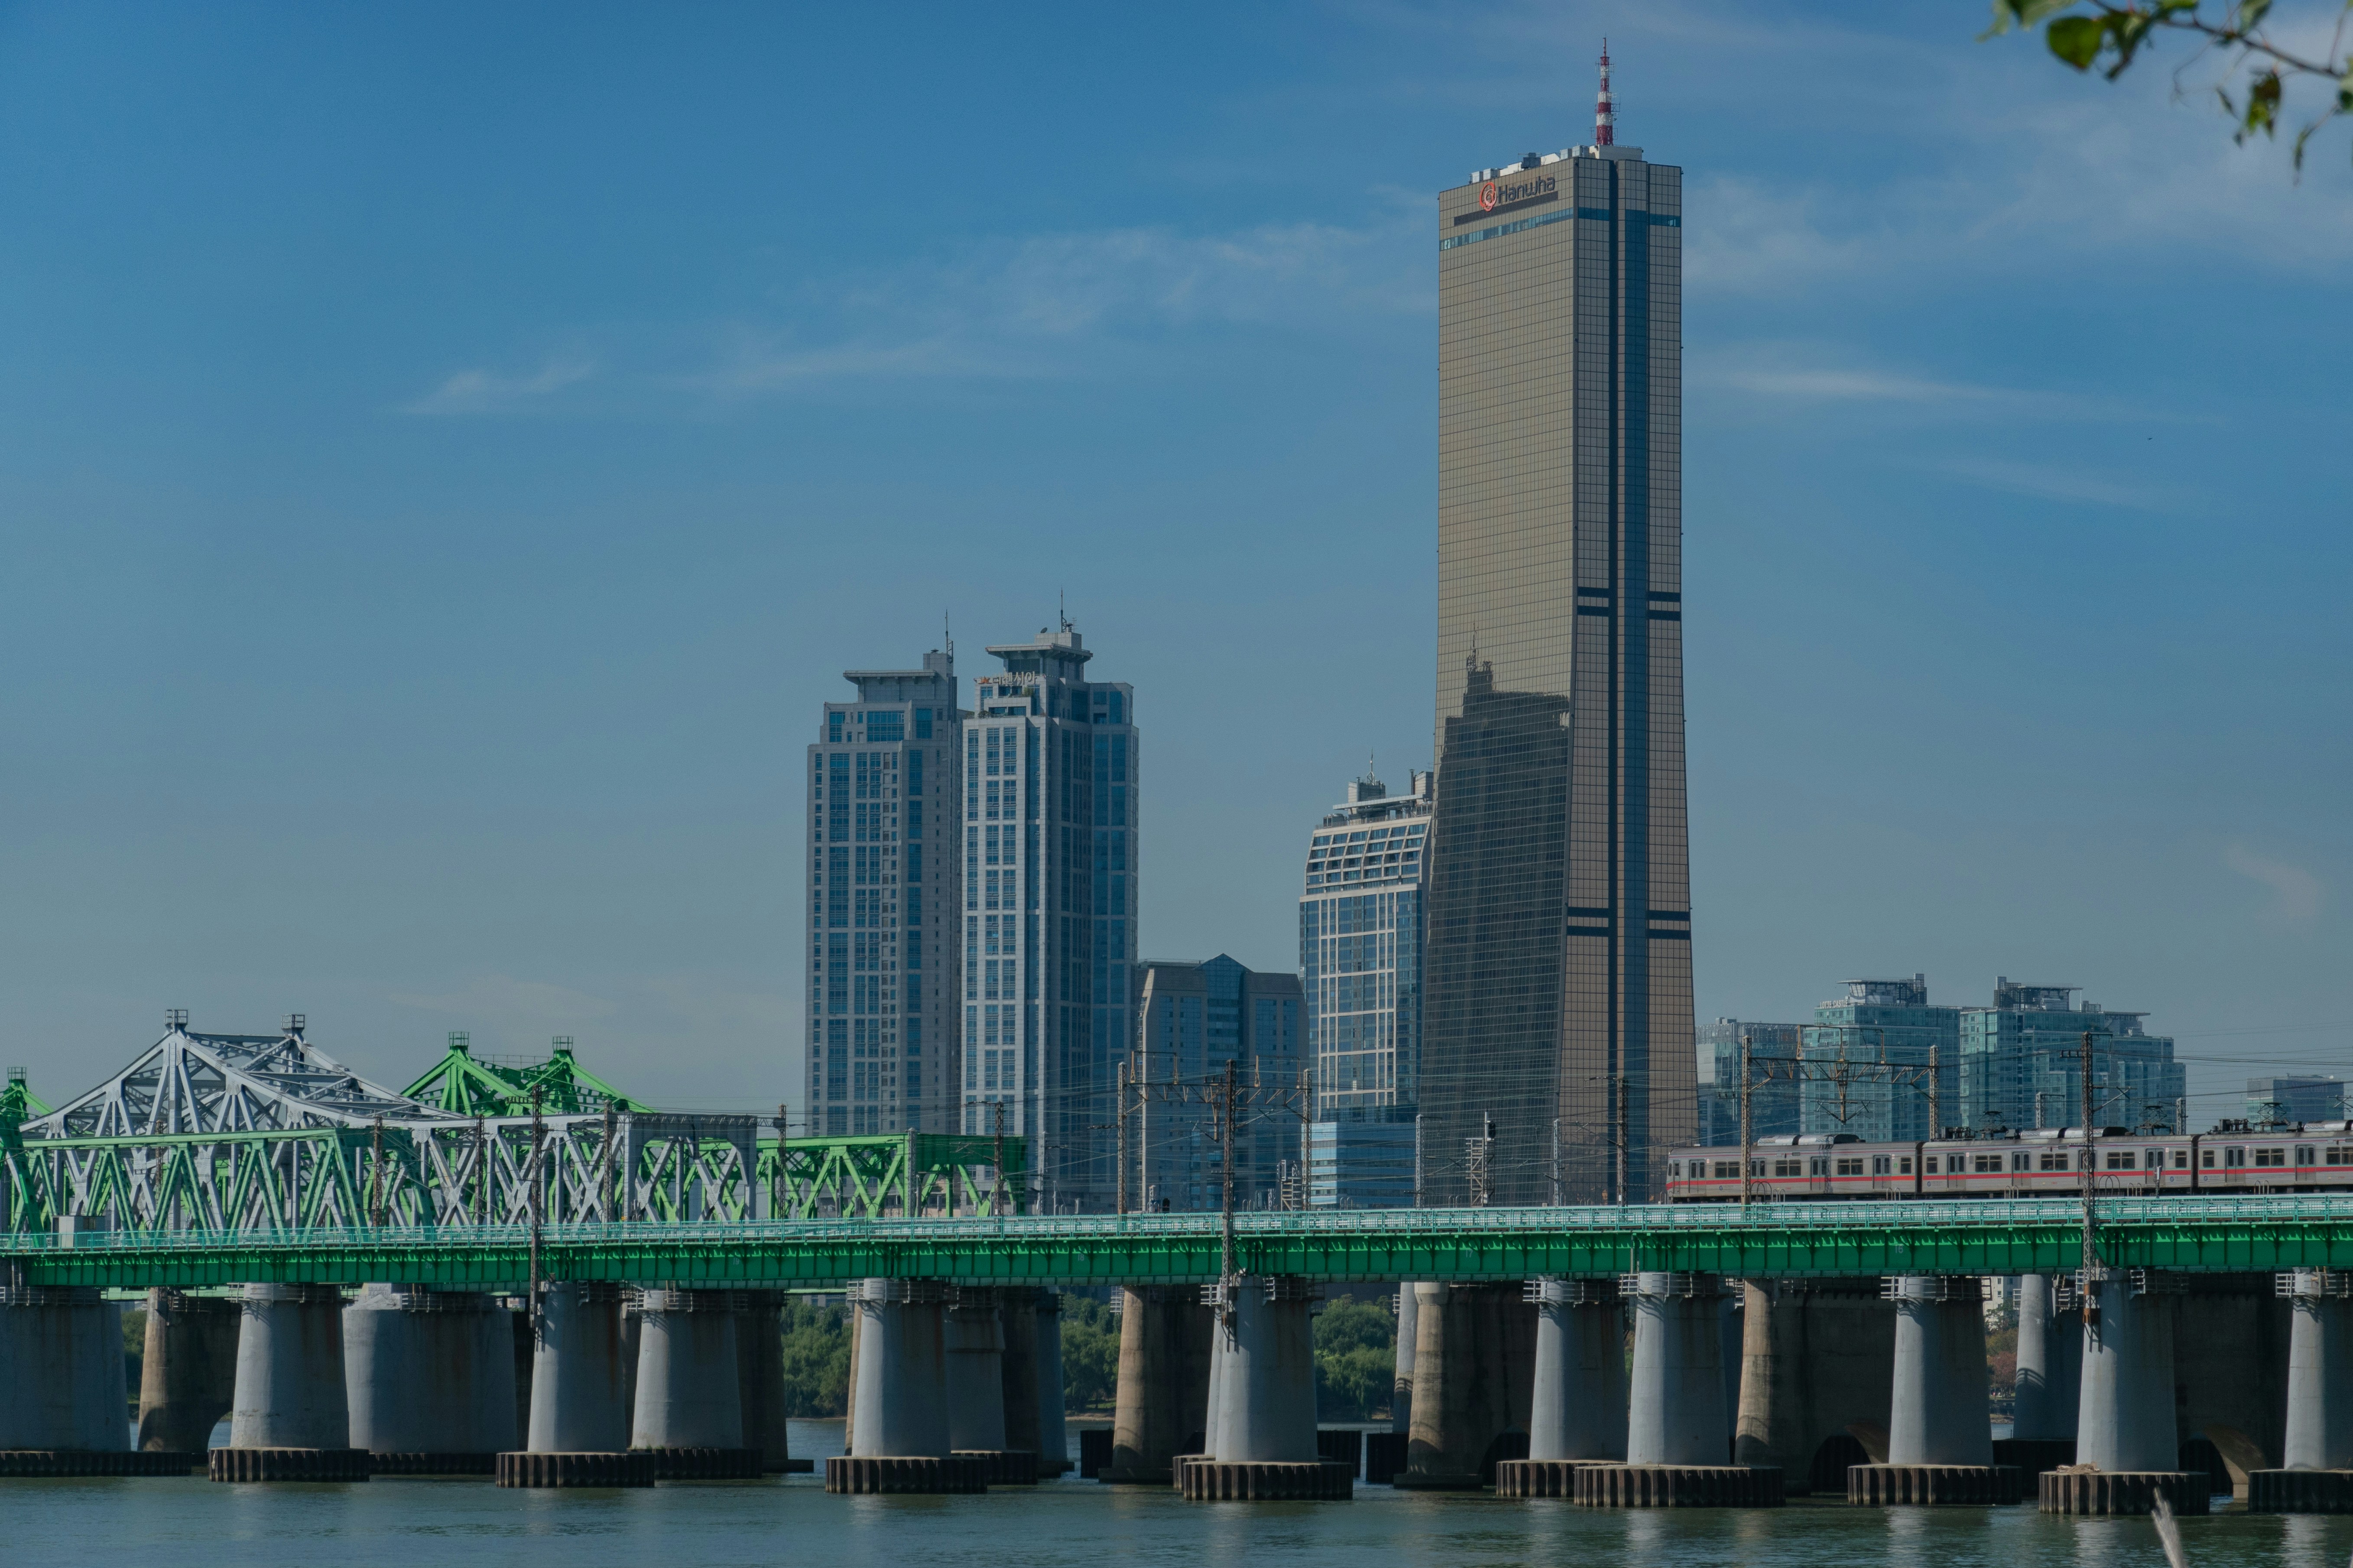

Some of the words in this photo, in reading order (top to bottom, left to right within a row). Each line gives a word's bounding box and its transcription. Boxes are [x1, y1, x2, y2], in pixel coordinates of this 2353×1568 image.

[1498, 176, 1555, 204] Hanwha
[1820, 1001, 1832, 1009] LOTTE
[1833, 999, 1848, 1008] CASTLE
[1466, 1249, 1473, 1257] 17
[1895, 1244, 1903, 1253] 16
